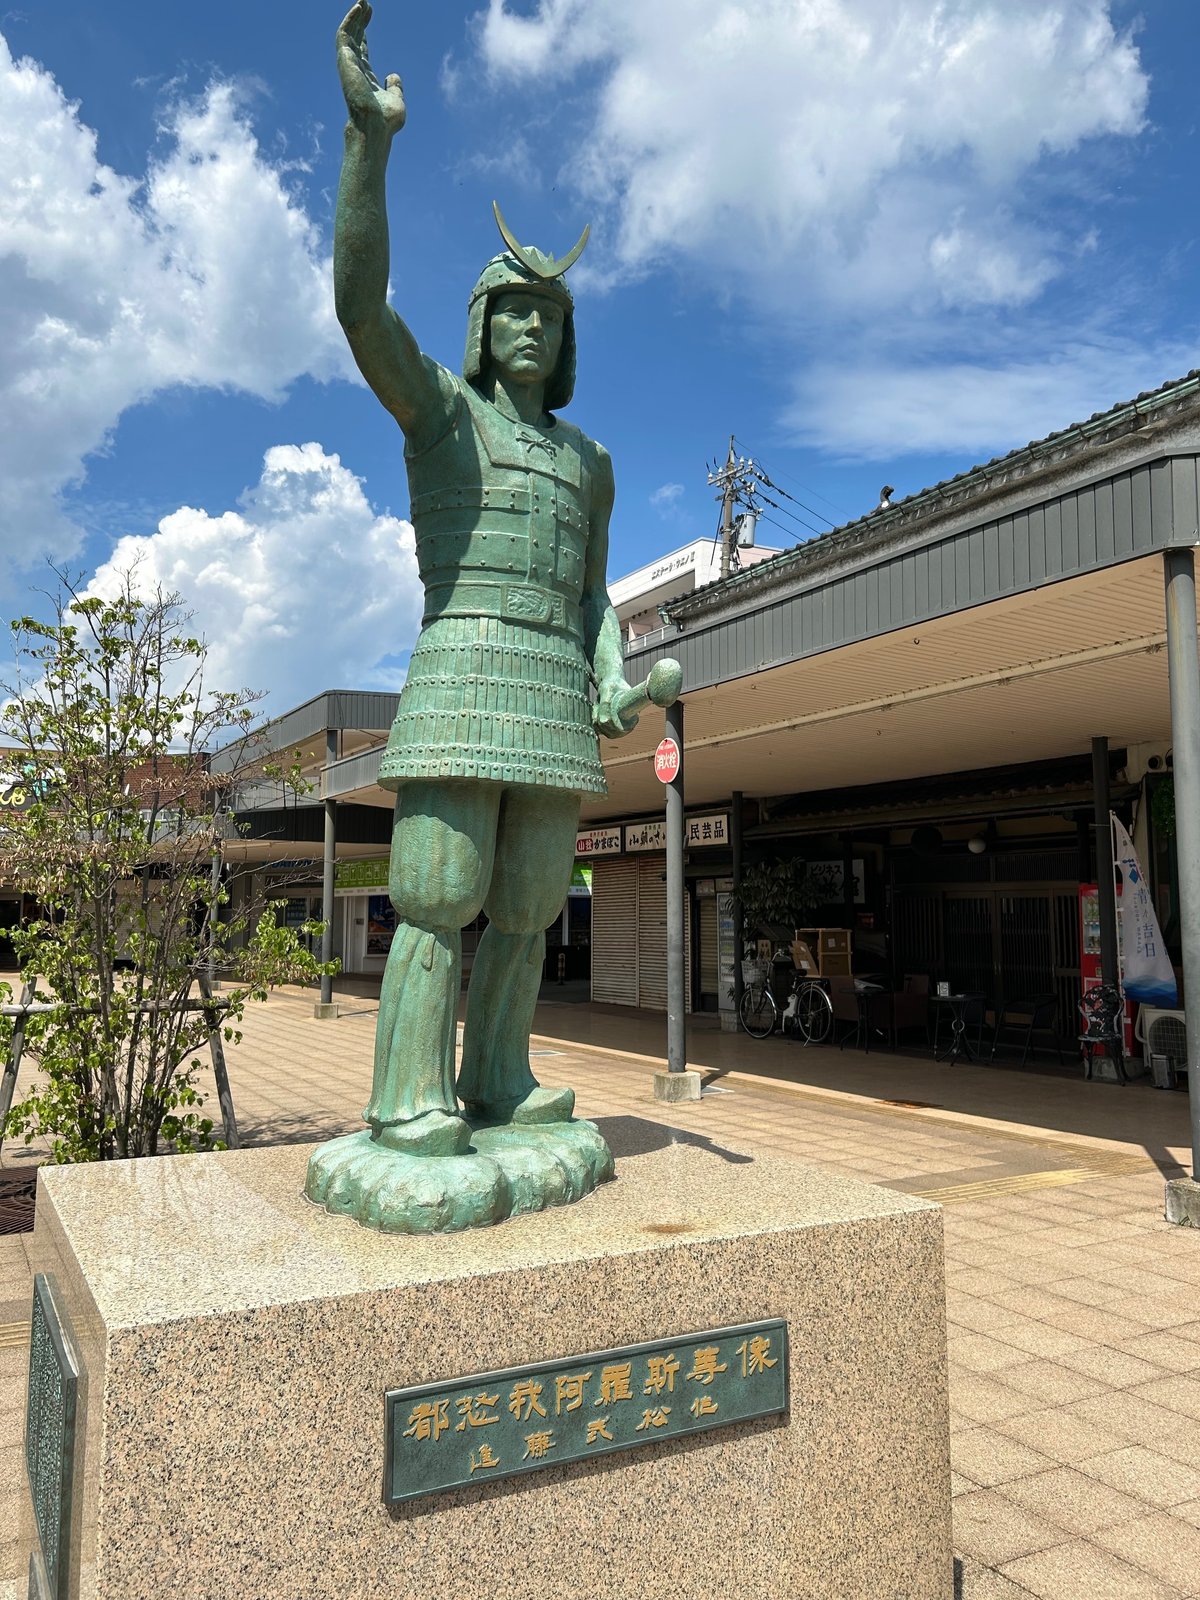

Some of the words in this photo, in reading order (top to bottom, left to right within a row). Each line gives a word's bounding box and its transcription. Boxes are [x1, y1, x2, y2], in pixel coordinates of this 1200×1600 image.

[656, 751, 677, 771] 消火栓
[690, 820, 724, 841] 民芸品
[810, 864, 842, 876] ビジネス
[470, 1395, 719, 1475] 進藤武松作
